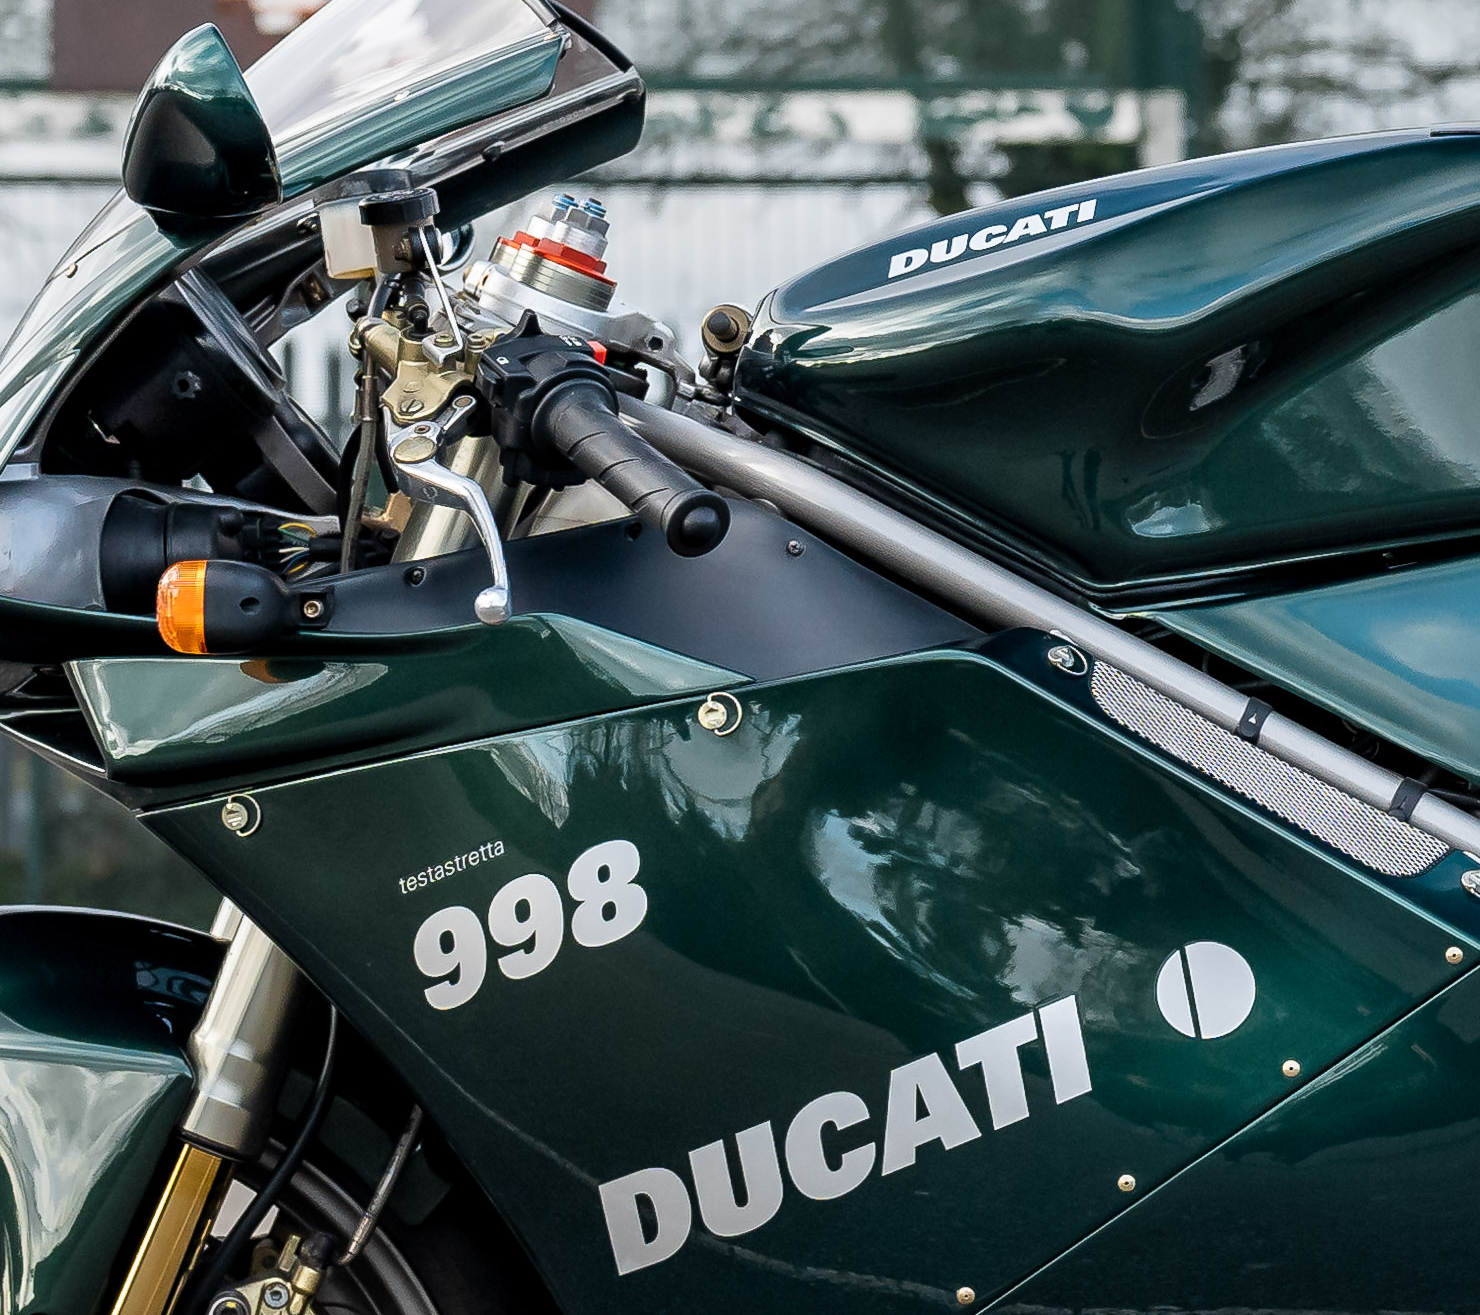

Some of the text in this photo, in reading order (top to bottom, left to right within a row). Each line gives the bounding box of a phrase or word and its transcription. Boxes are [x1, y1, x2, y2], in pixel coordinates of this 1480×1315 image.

[888, 199, 1097, 278] DUCATI
[399, 841, 504, 894] testastretta
[414, 840, 647, 1009] 998
[599, 995, 1092, 1275] DUCATI
